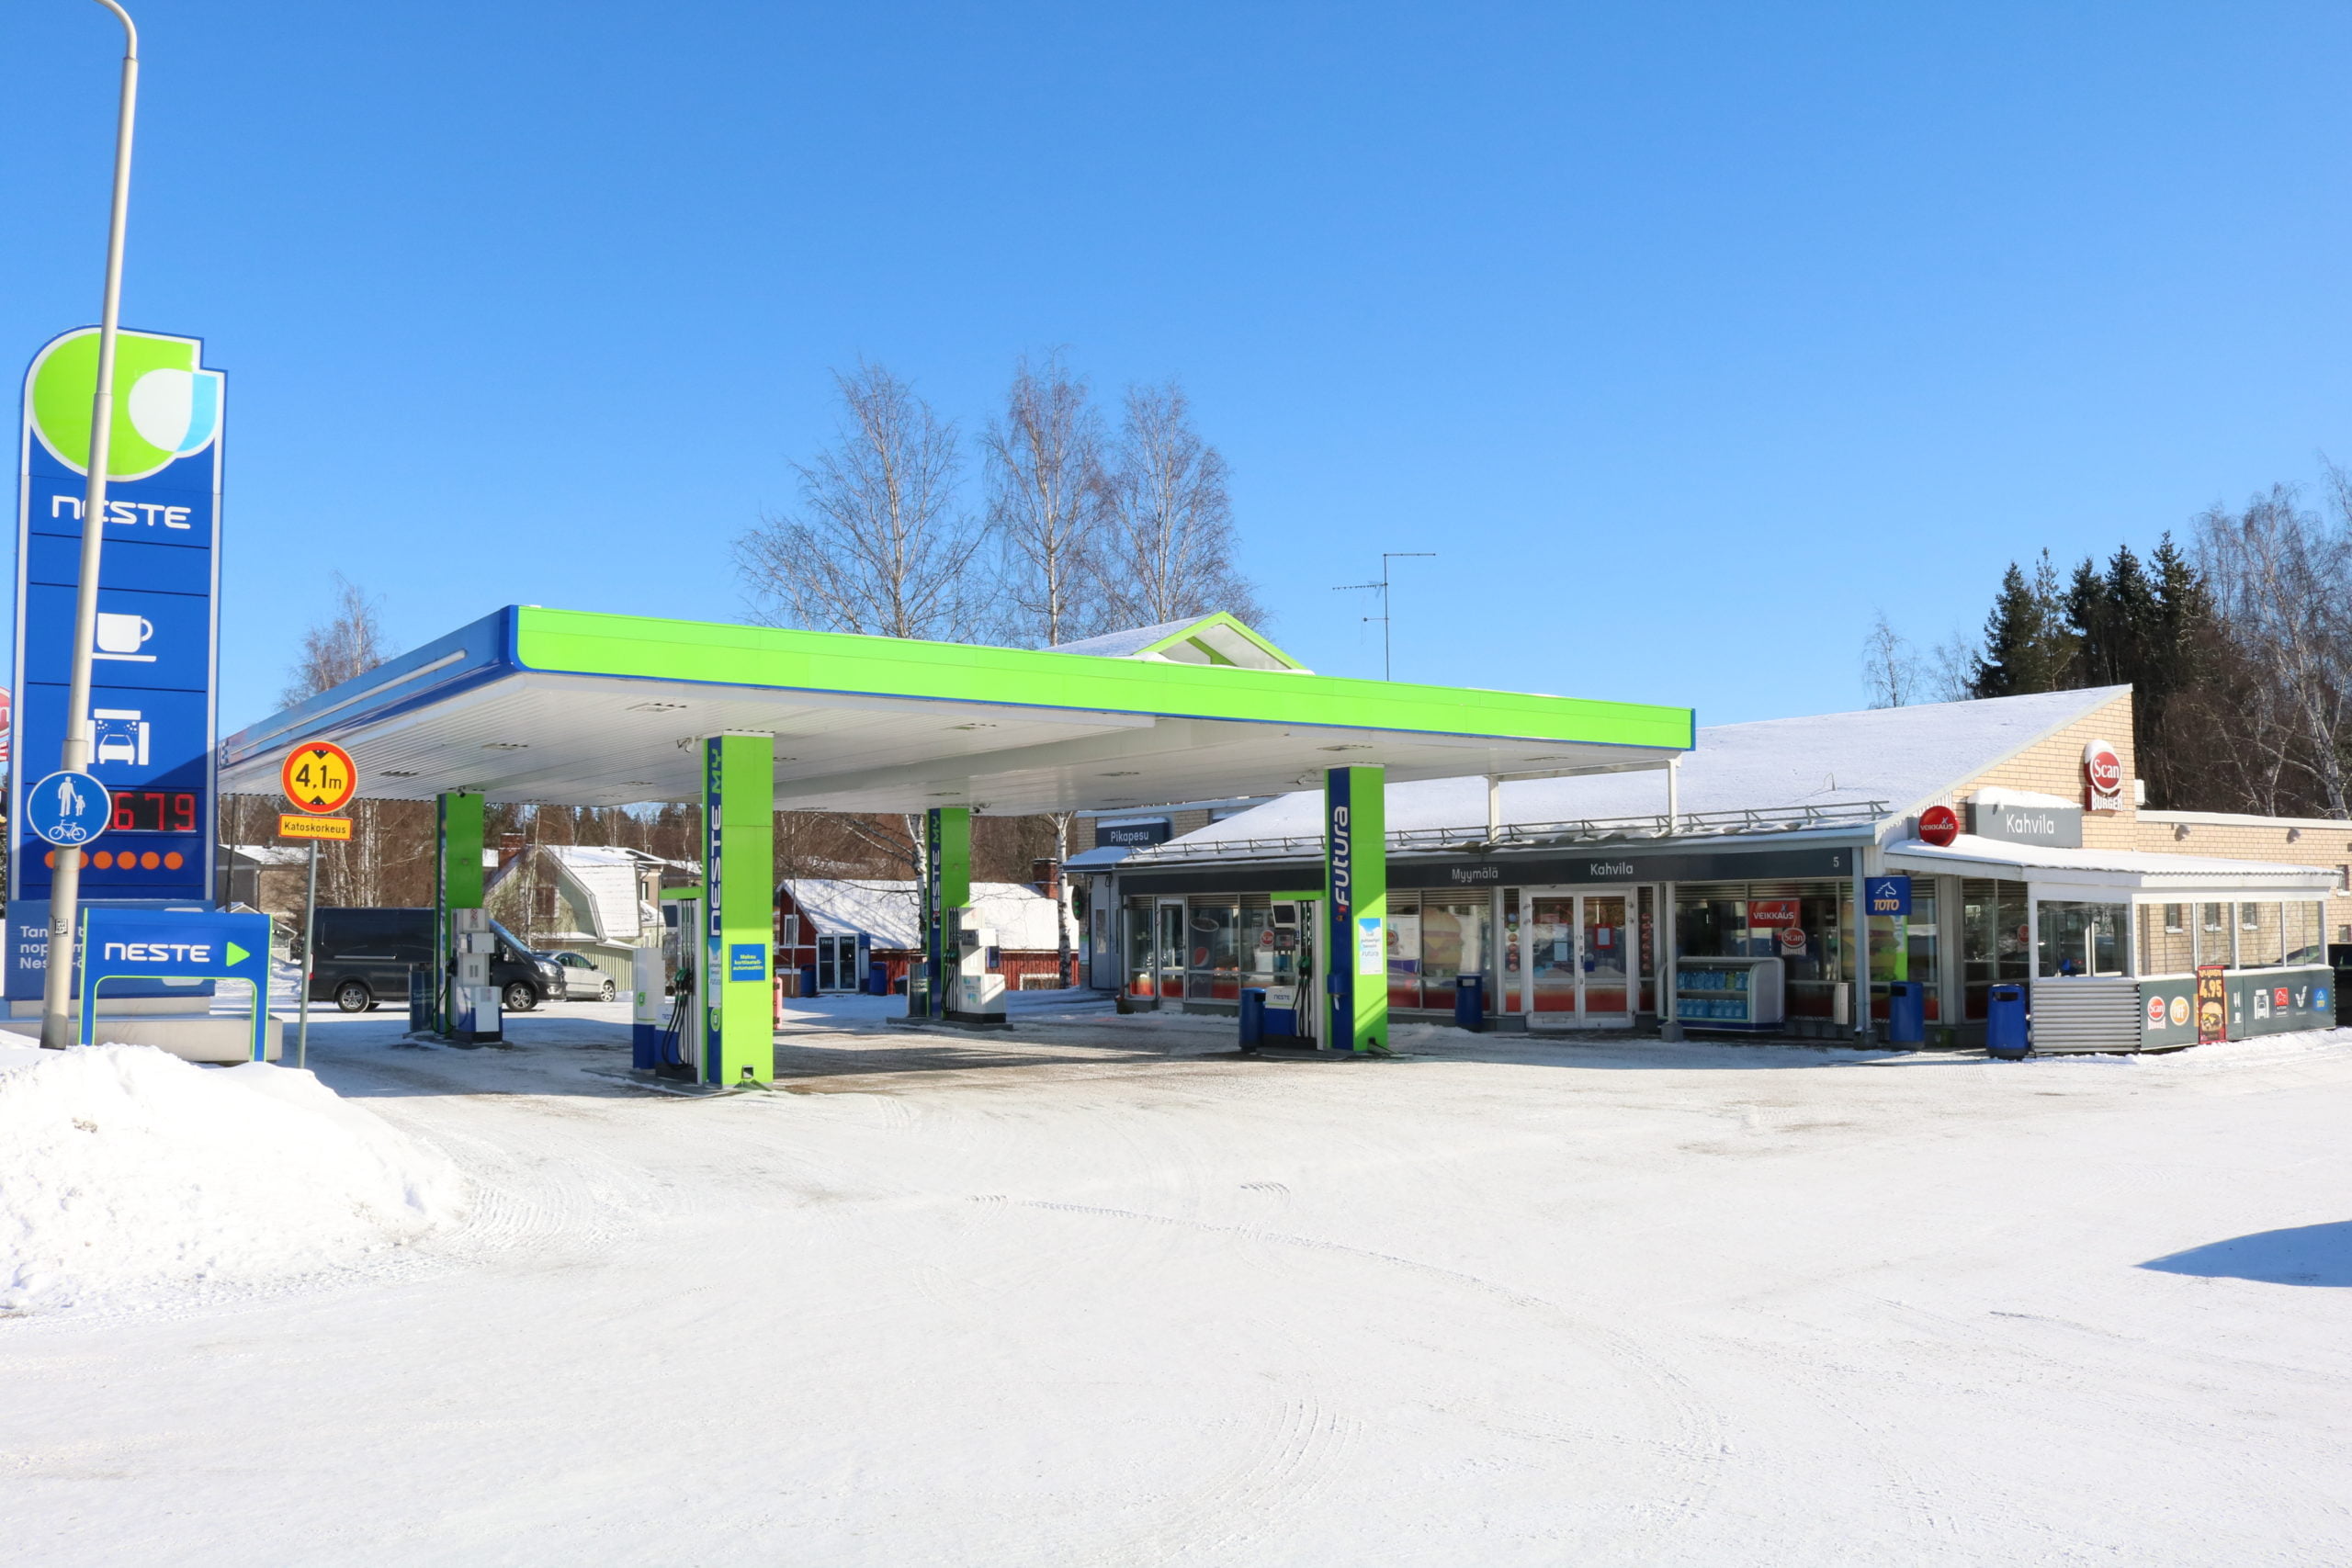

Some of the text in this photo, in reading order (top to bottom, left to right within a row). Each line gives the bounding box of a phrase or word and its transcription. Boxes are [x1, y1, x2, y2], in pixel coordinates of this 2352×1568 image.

[2094, 759, 2120, 779] Scan
[2091, 786, 2123, 811] BURGER
[284, 822, 346, 834] Katoskorkeus
[1919, 823, 1954, 831] VEIKKAUS
[2006, 813, 2054, 834] Kahvila
[711, 749, 721, 936] NESTE MY
[1110, 830, 1149, 844] Pikapesu
[1590, 862, 1634, 875] Kahvila
[1833, 856, 1839, 868] 5
[932, 816, 940, 929] NESTE MY
[1452, 867, 1498, 883] Myymälä
[1873, 899, 1900, 911] TOTO
[1753, 911, 1794, 919] VEIKKAUS
[105, 942, 210, 963] NESTE
[2199, 979, 2222, 998] 4.95
